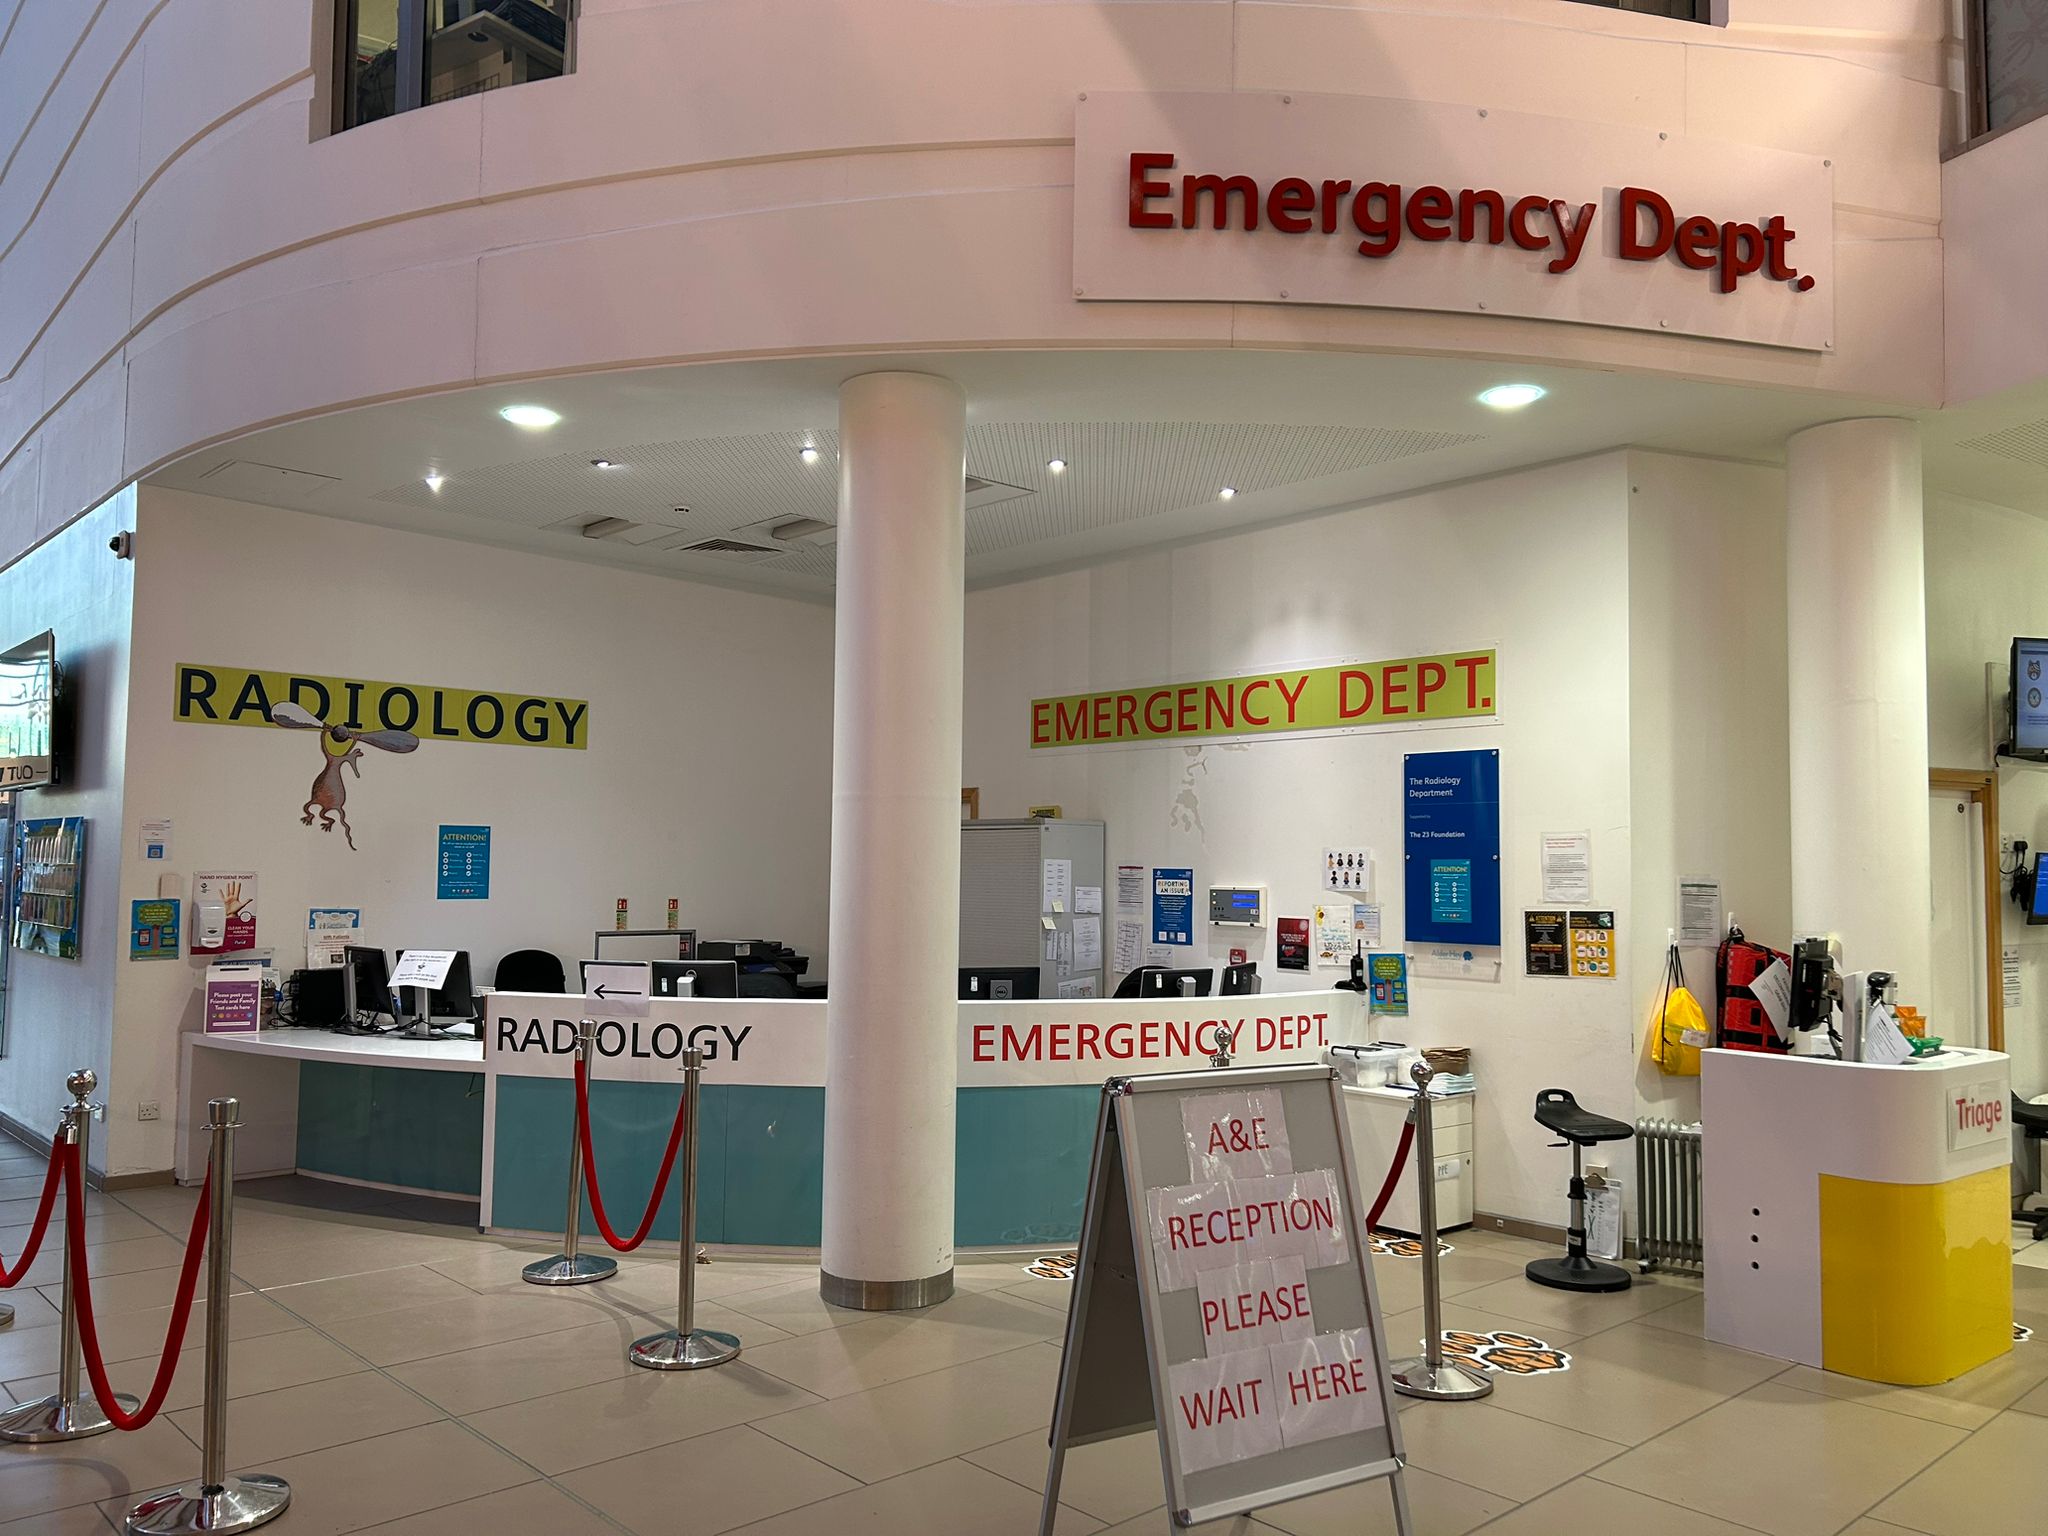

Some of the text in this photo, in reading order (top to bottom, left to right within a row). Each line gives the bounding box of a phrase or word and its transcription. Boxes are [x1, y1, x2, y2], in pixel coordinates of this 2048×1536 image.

[1129, 152, 1816, 294] Emergency Dept.
[179, 667, 586, 744] RADIOLOGY
[1033, 656, 1491, 744] EMERGENCY DEPT.
[1409, 776, 1461, 786] The Radiology
[1409, 789, 1453, 798] Department
[239, 997, 256, 1005] Family
[497, 1017, 753, 1062] RADOLOGY
[973, 1013, 1329, 1062] EMERGENCY DEPT.
[1207, 1117, 1270, 1154] A&E
[1955, 1097, 2002, 1133] Triage
[1168, 1197, 1334, 1250] RECEPTION
[1202, 1282, 1310, 1335] PLEASE
[1180, 1358, 1367, 1430] WAIT HERE
